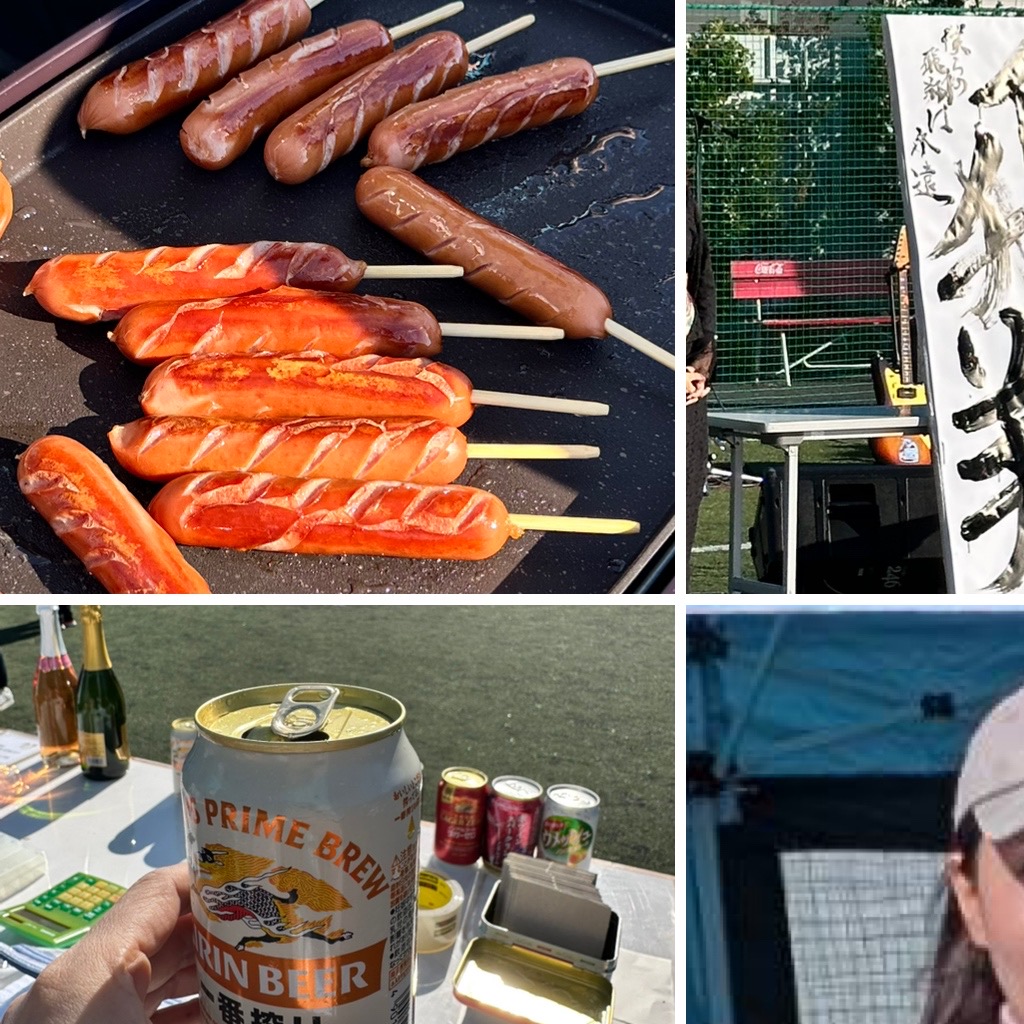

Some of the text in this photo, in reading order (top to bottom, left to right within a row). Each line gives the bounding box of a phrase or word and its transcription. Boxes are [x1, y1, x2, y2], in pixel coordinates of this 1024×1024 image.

[204, 798, 311, 849] PRIME
[313, 831, 390, 900] BREW
[194, 922, 369, 1000] RIN BEER
